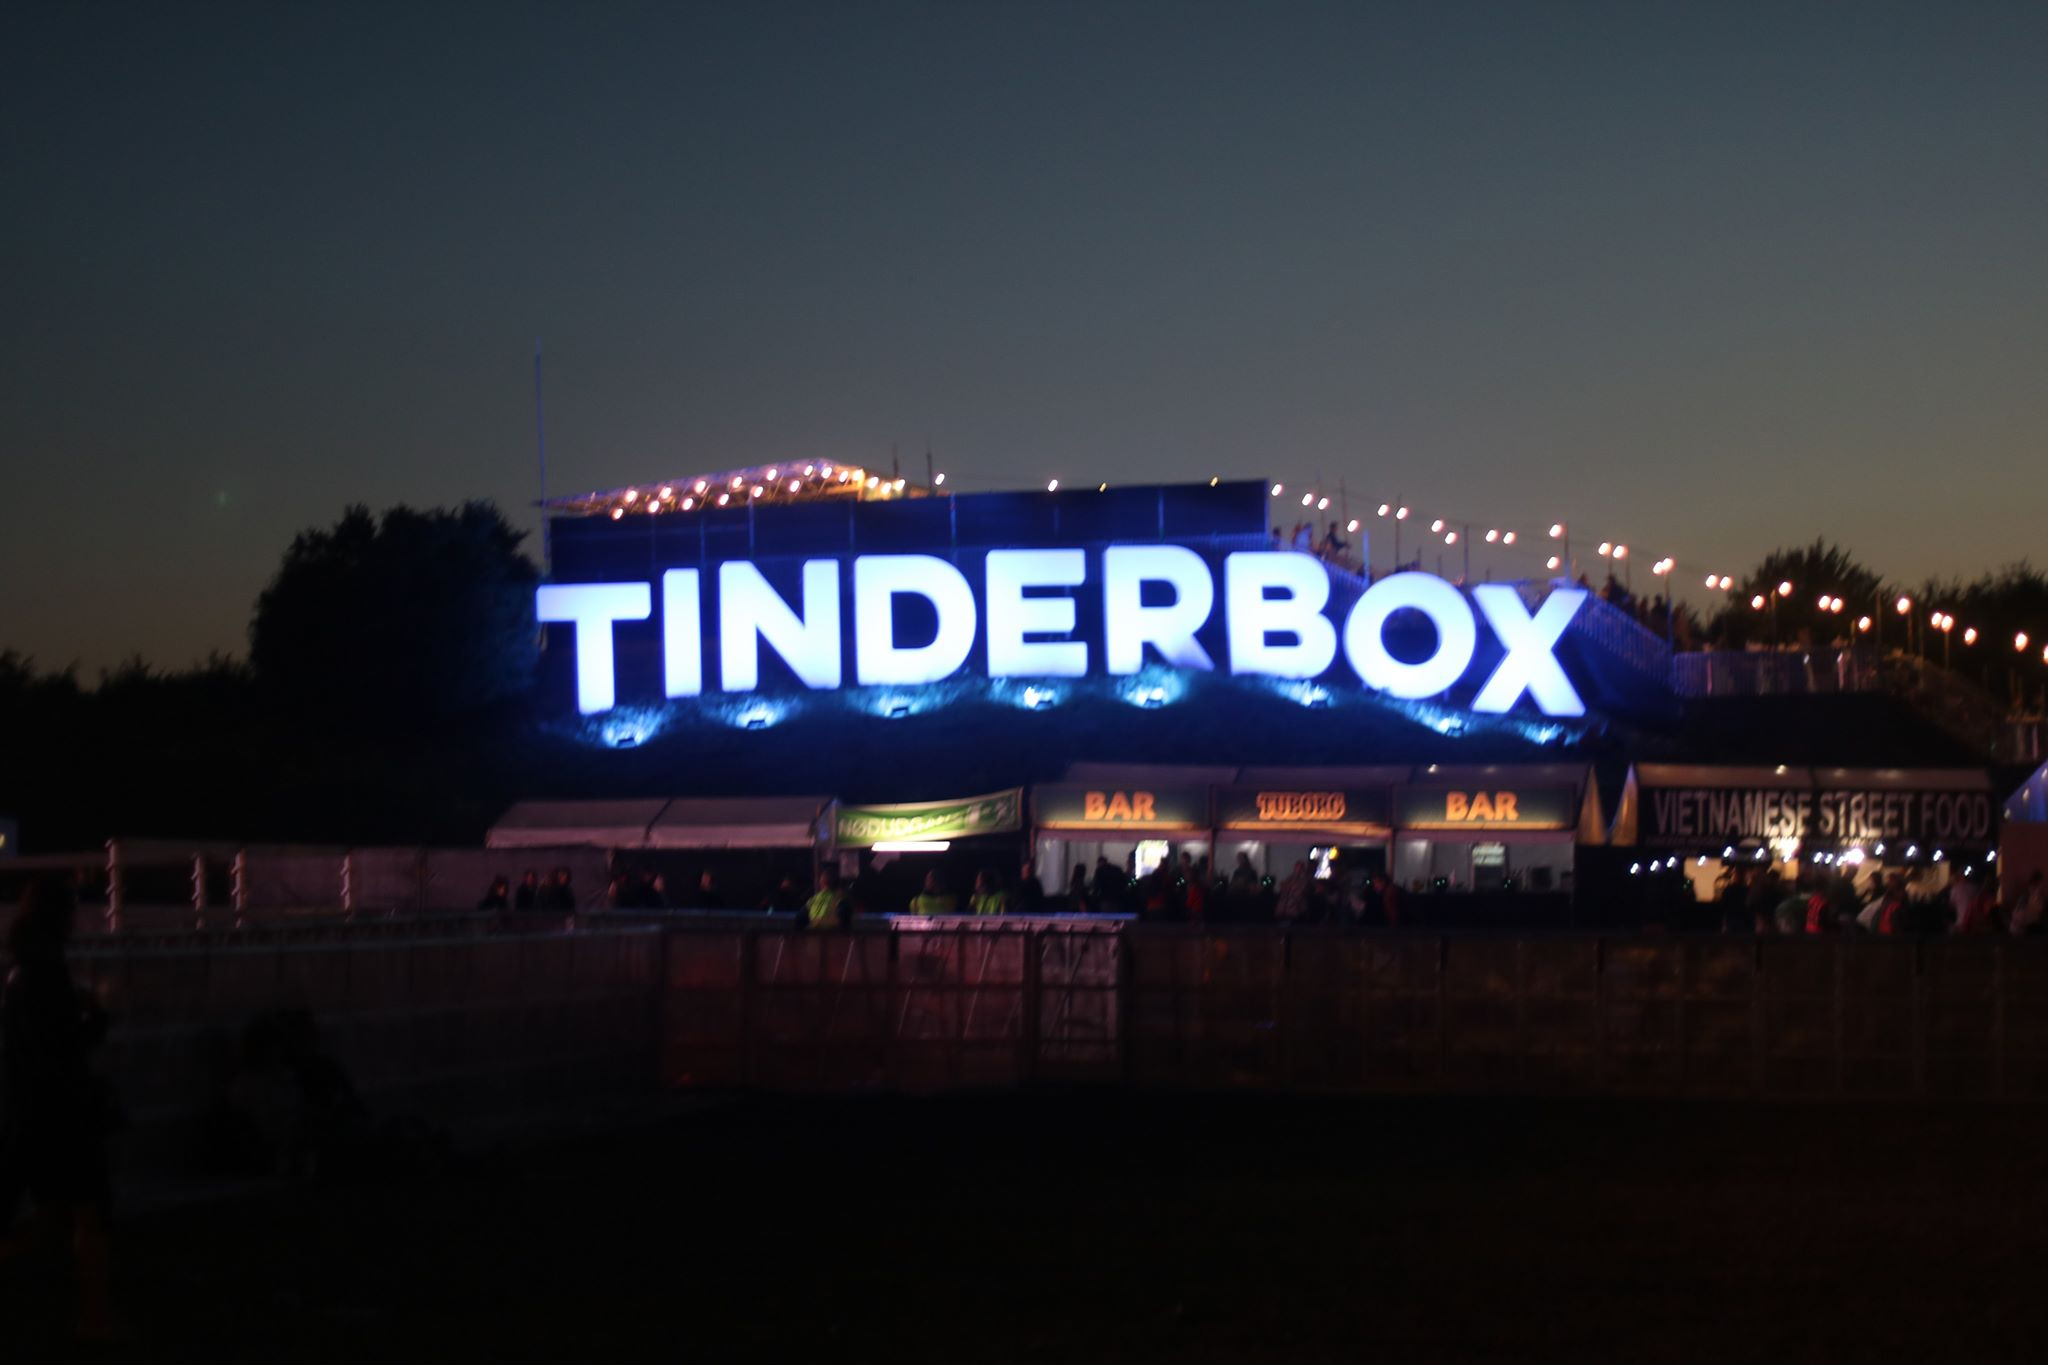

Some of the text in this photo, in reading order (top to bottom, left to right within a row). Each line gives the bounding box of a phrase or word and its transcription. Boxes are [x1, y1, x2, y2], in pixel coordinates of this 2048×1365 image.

[536, 545, 1588, 717] TINDERBOX
[1084, 790, 1156, 821] BAR
[1256, 791, 1346, 821] TUBORG
[1446, 791, 1519, 821] BAR
[1653, 789, 1990, 839] VIETNAMESE STREET FOOD
